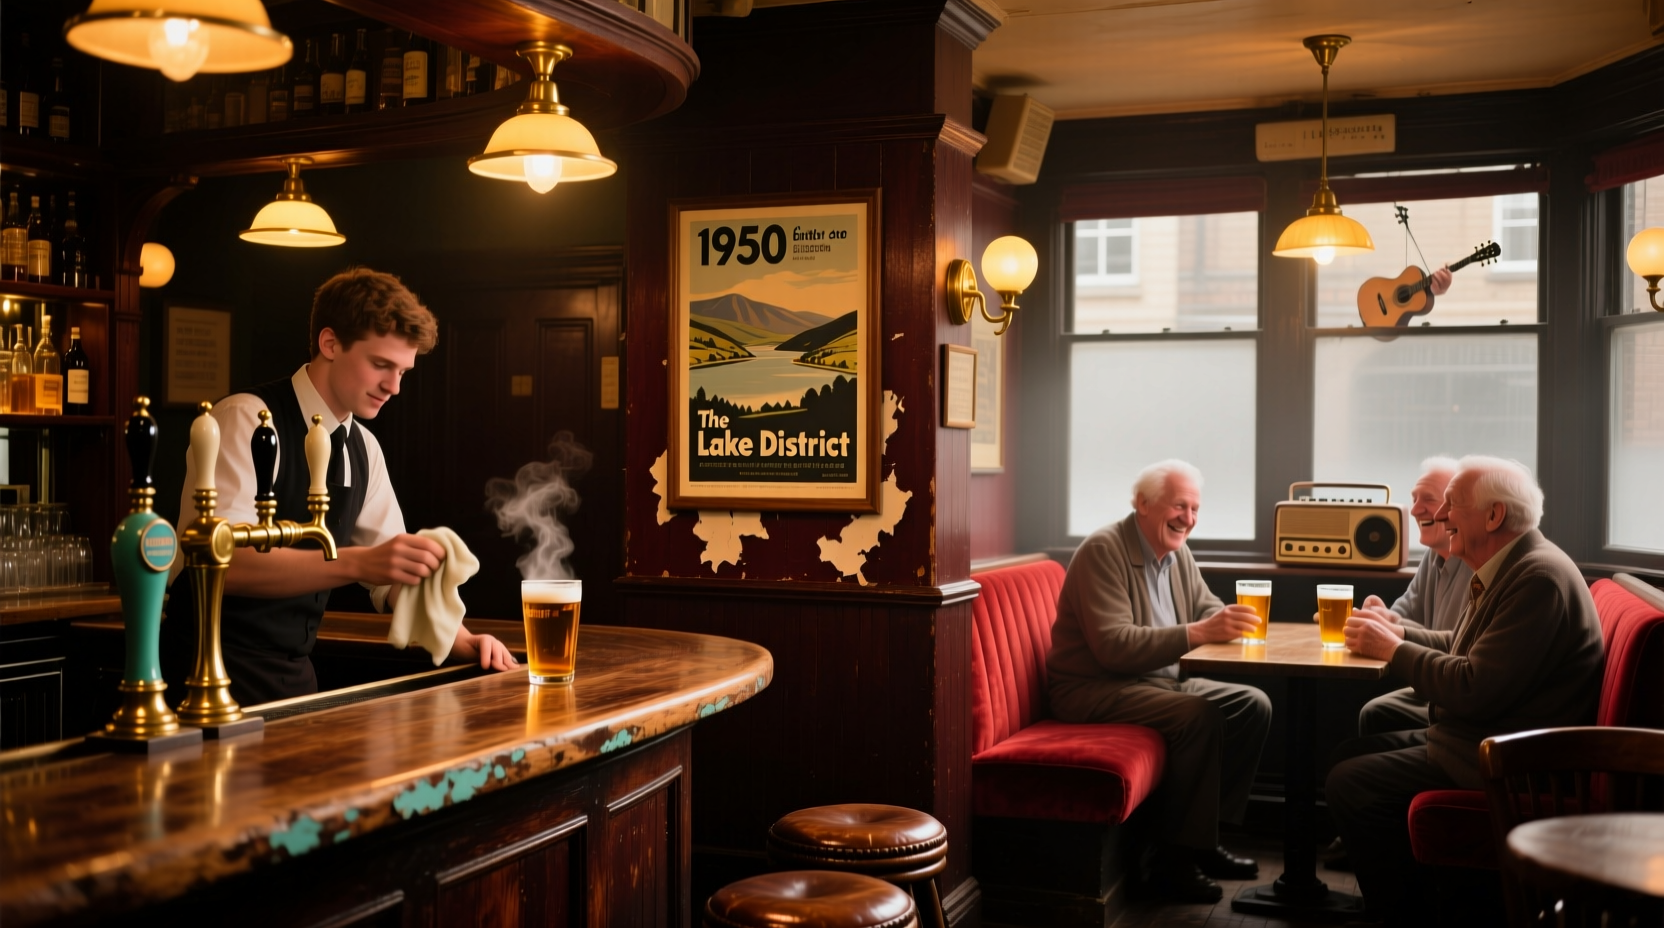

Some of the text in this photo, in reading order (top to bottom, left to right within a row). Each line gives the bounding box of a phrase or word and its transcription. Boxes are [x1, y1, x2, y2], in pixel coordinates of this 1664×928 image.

[698, 224, 787, 266] 1950
[698, 409, 729, 428] The
[698, 430, 850, 457] Lake District
